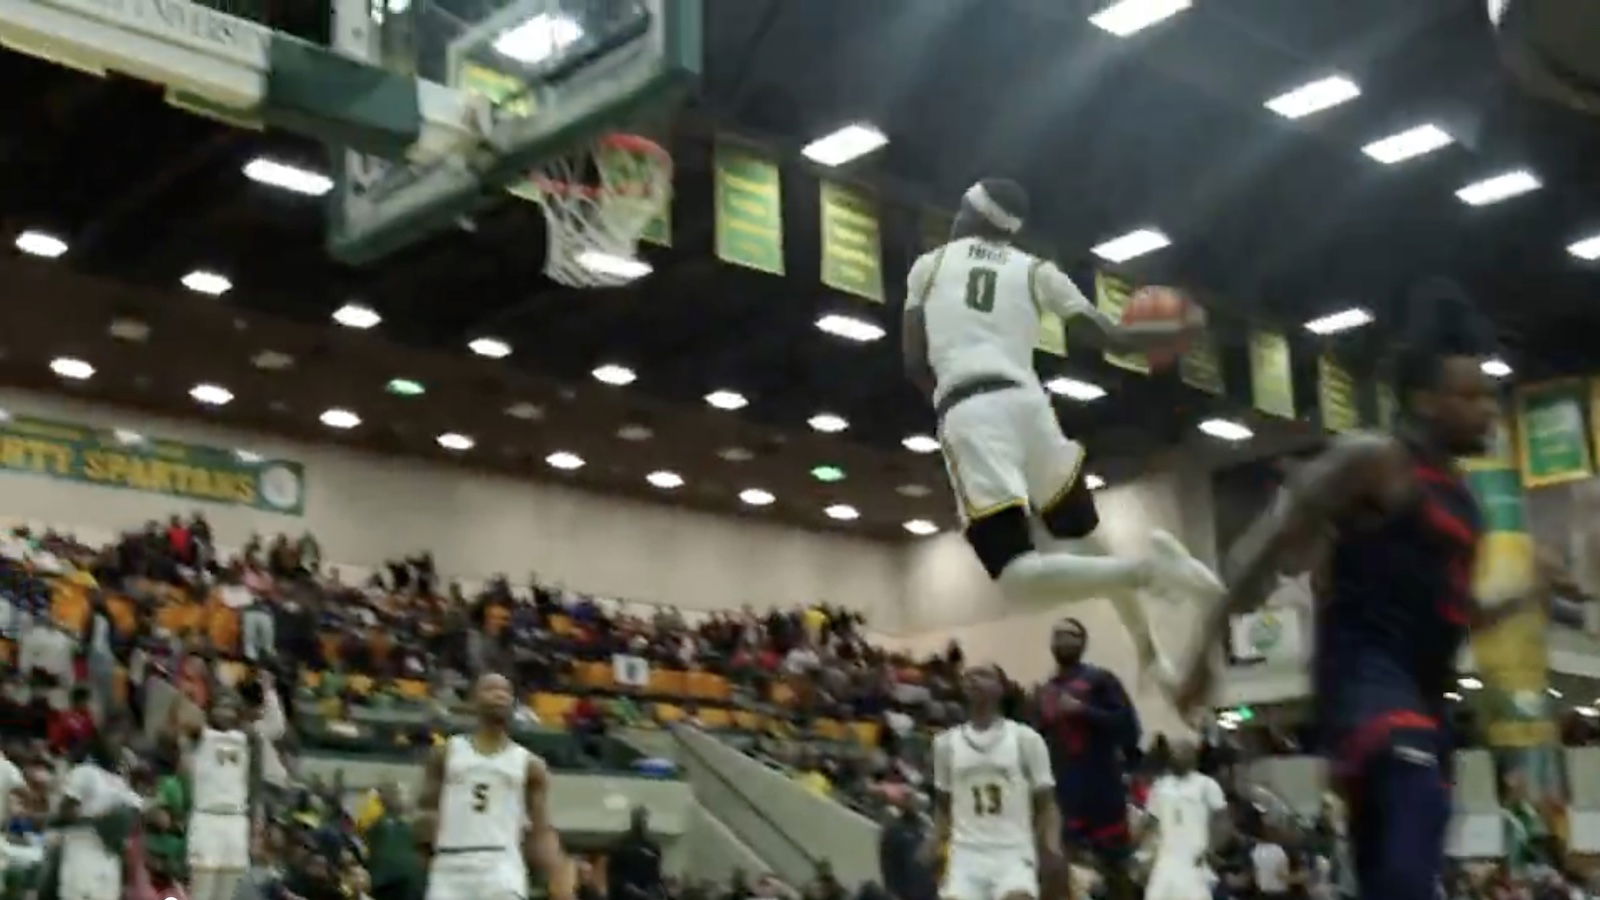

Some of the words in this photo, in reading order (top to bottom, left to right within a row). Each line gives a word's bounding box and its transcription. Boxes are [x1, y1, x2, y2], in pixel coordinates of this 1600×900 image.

[965, 266, 998, 314] 0
[83, 449, 258, 504] SPARTANS
[970, 783, 1003, 816] 13
